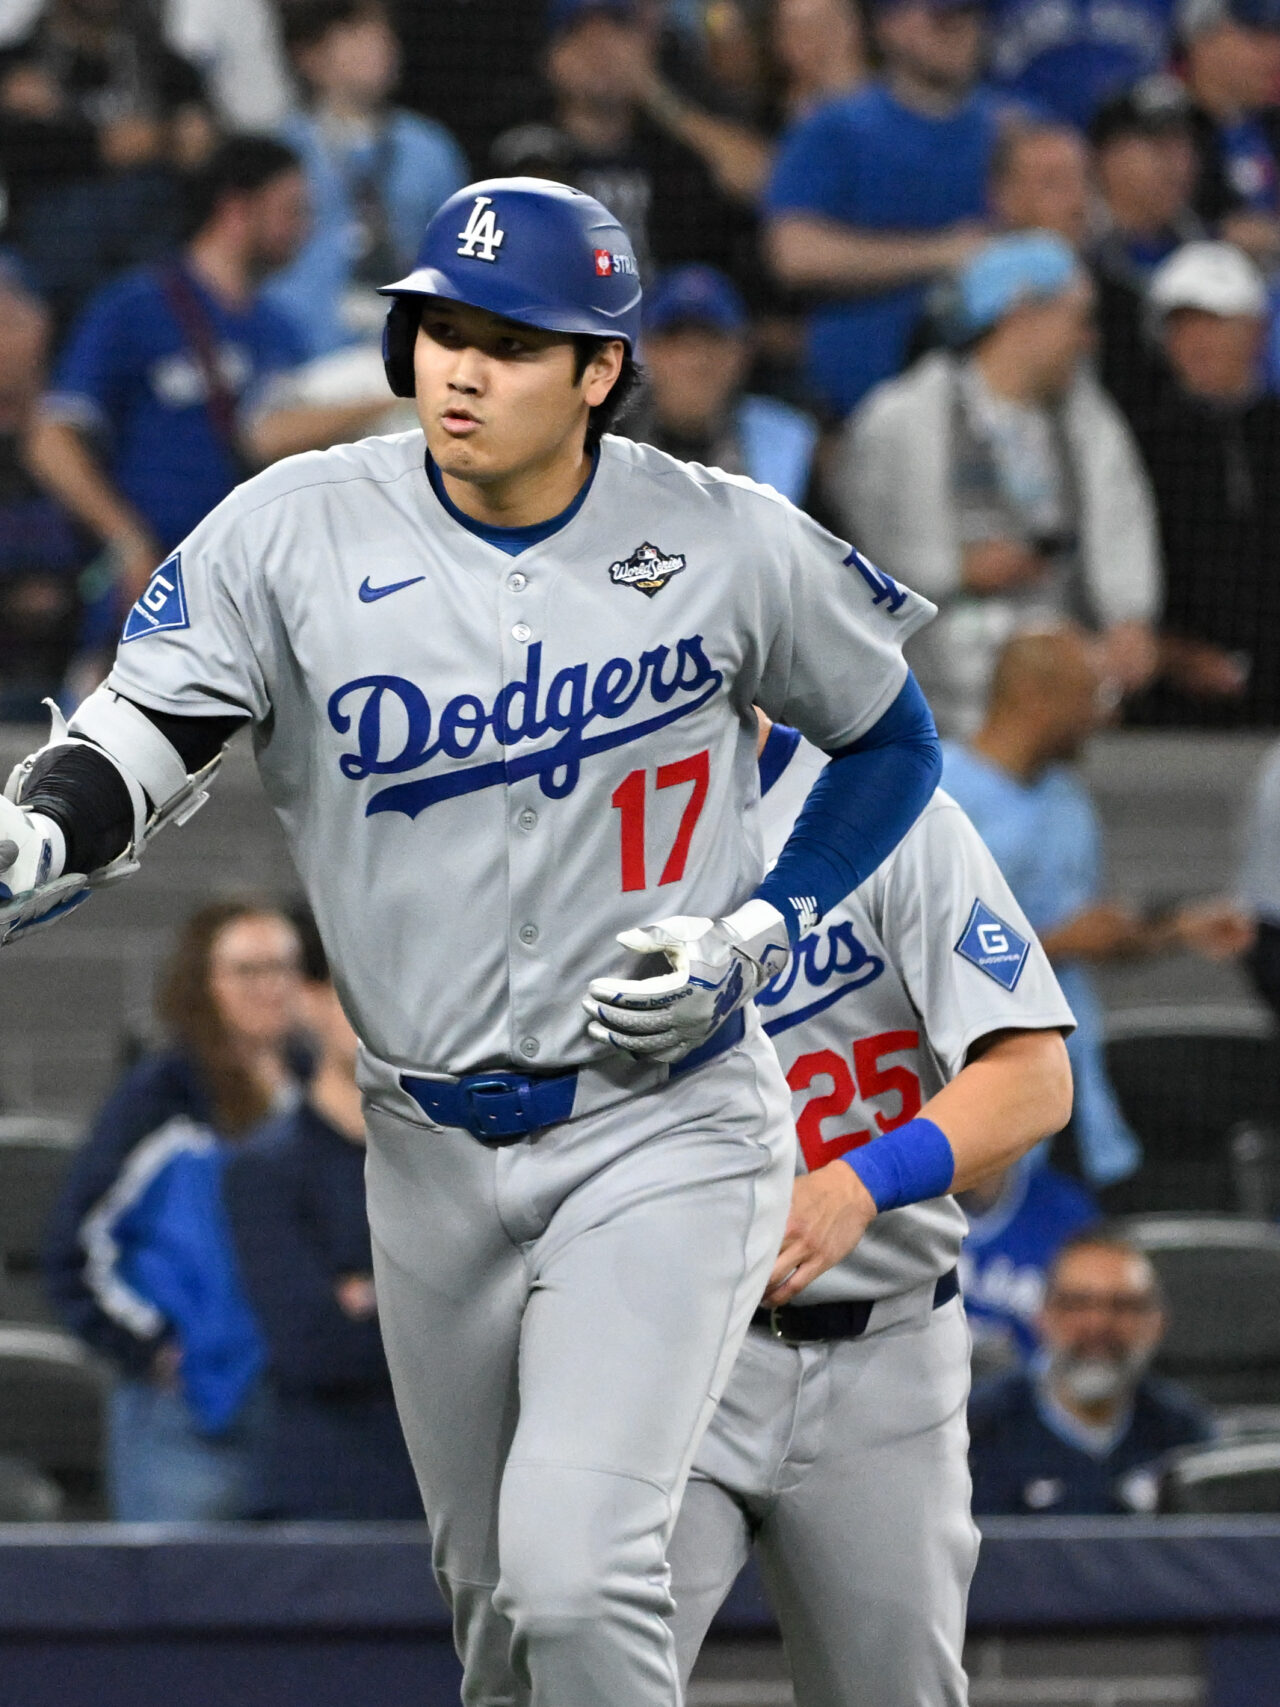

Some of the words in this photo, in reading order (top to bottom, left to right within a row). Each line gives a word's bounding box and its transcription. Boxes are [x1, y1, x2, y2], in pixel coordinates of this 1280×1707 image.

[457, 196, 505, 261] LA
[143, 574, 175, 612] G
[612, 562, 652, 582] World
[328, 635, 722, 820] Dodgers
[611, 749, 710, 892] 17
[976, 923, 1009, 954] G
[785, 1029, 922, 1172] 25
